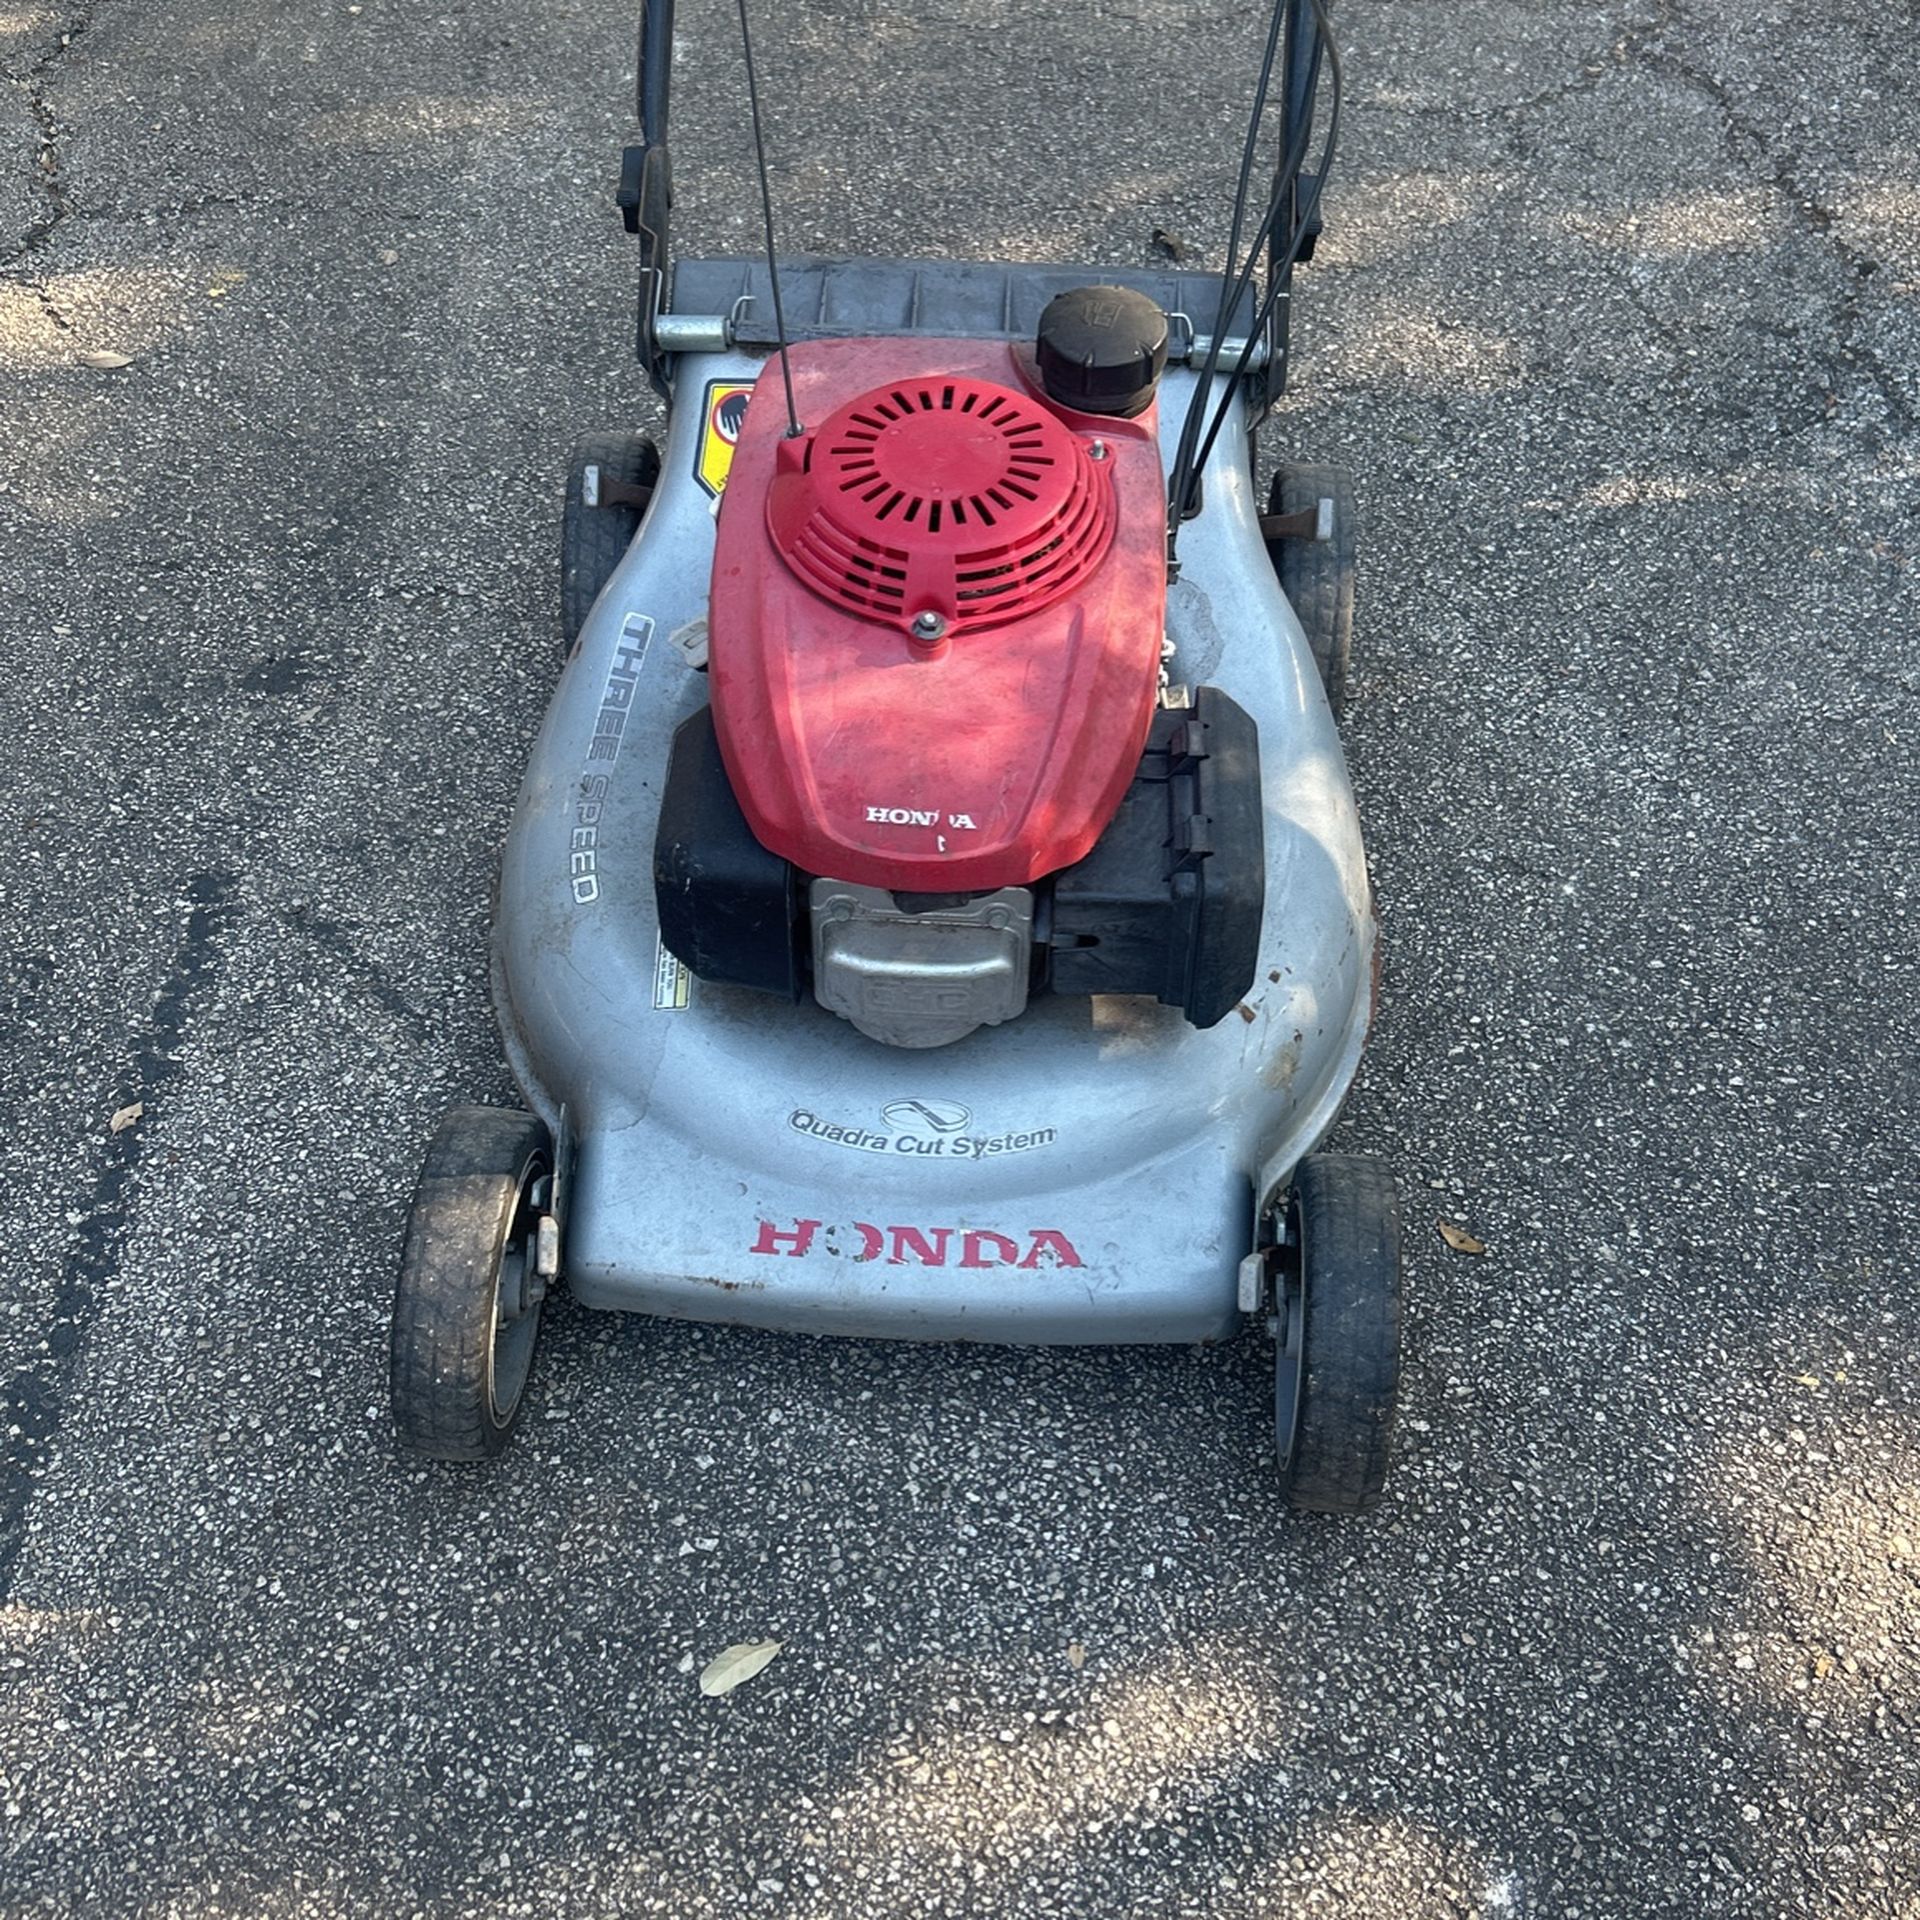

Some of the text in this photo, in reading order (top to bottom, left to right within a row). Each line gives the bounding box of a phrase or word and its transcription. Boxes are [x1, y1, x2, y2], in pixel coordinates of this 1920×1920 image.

[570, 614, 654, 904] THREE SPEED
[865, 806, 977, 829] HONA
[790, 1109, 1054, 1159] Quadra Cut System
